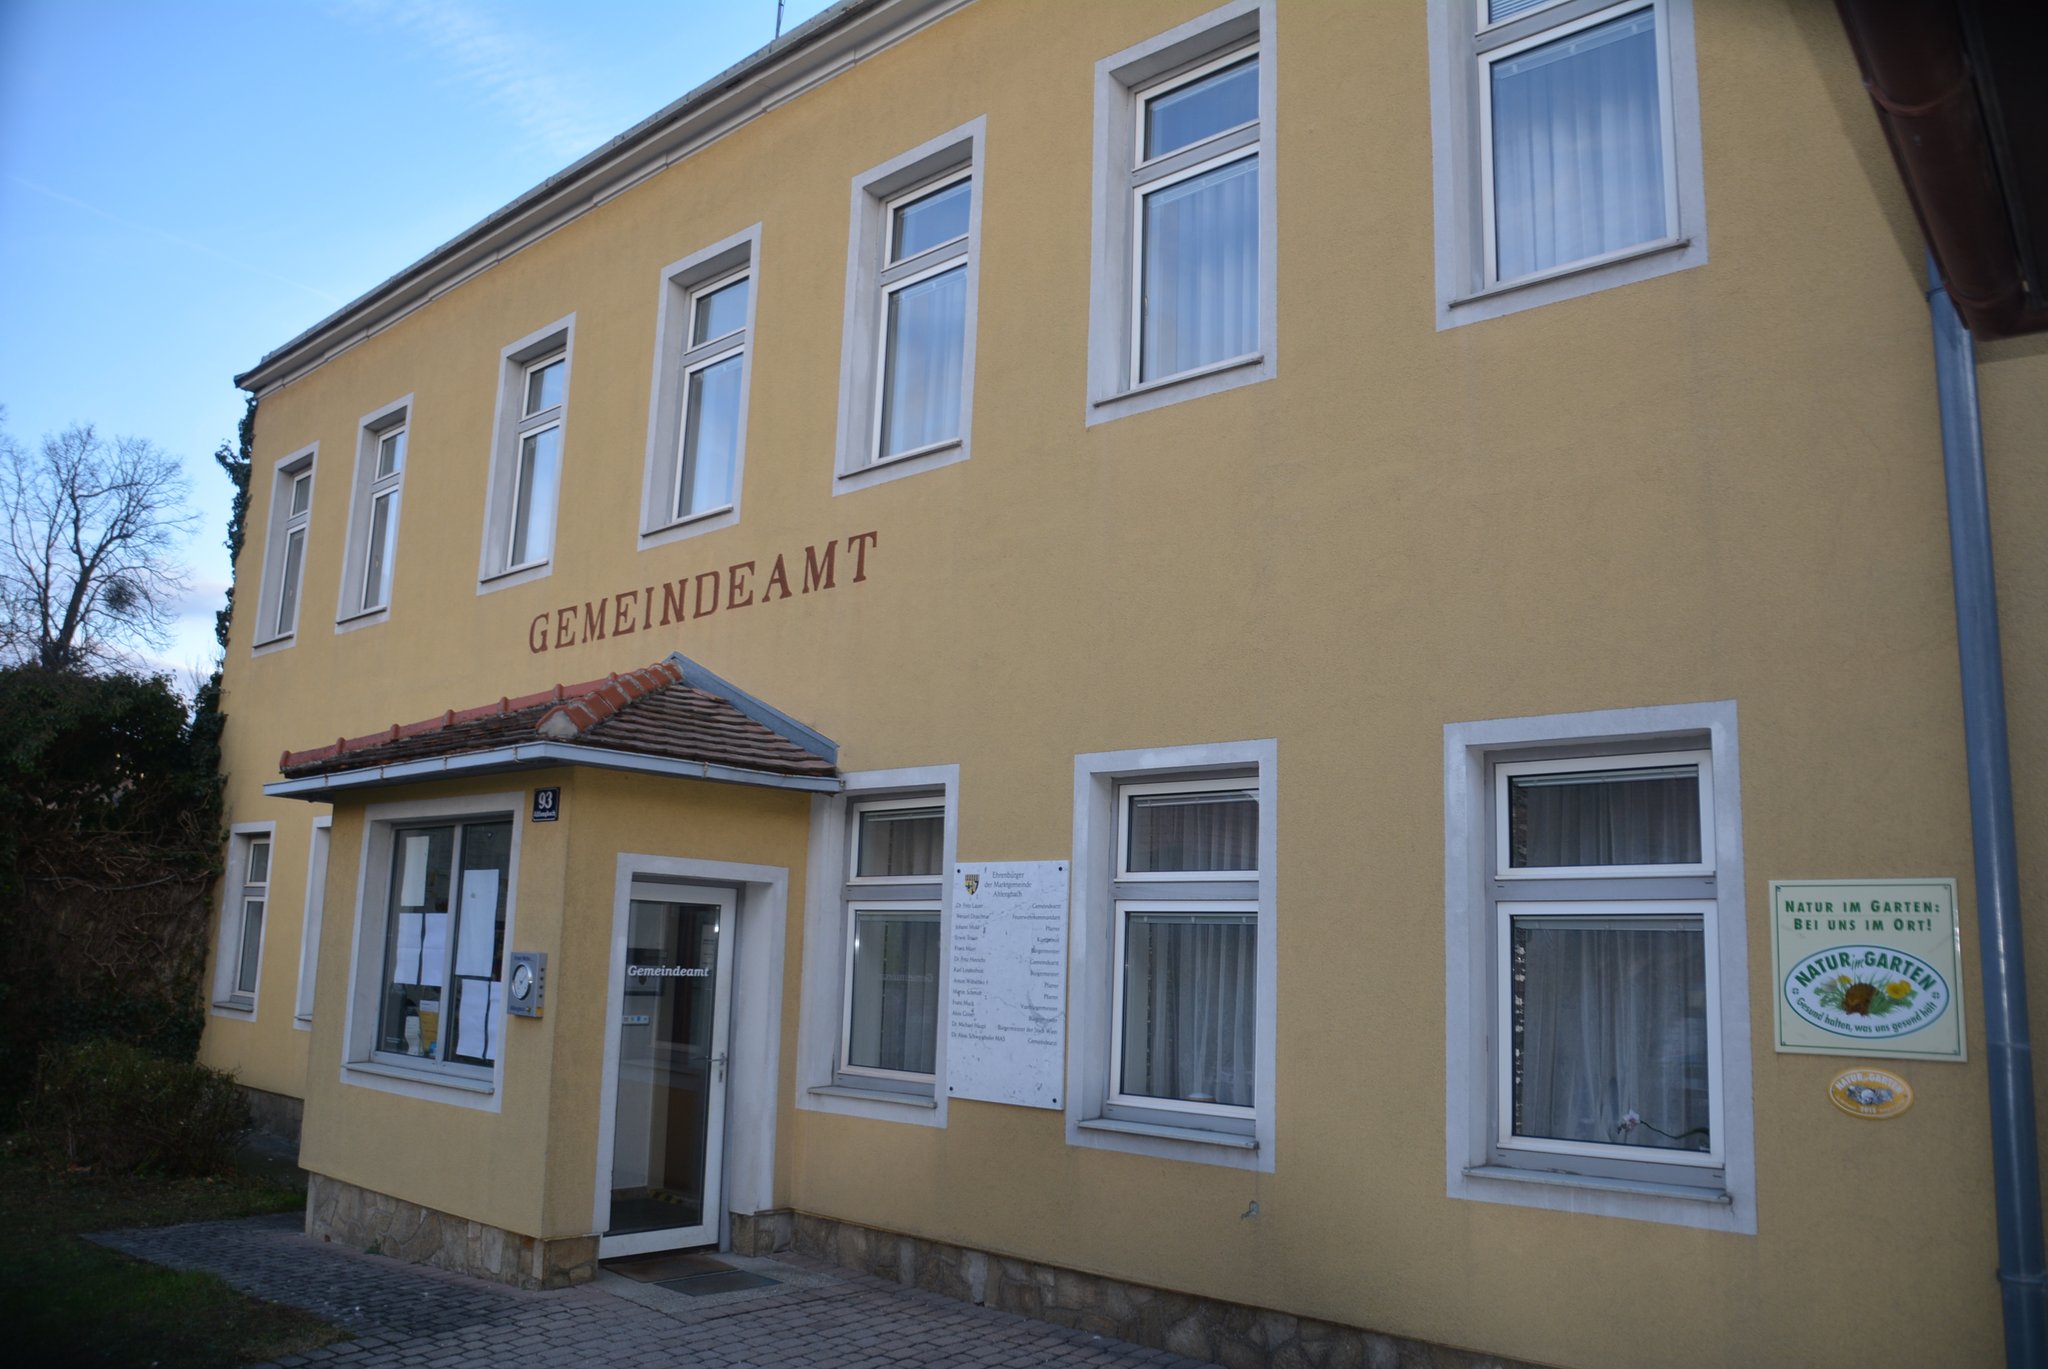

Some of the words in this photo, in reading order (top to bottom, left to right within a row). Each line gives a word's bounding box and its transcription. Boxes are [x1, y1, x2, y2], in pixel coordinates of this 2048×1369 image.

[529, 531, 877, 654] GEMEINDEAMT
[538, 791, 553, 809] 93
[628, 965, 709, 976] Gemeindeamt
[1795, 951, 1850, 987] NATUR
[1864, 951, 1937, 991] GARTEN
[1796, 997, 1824, 1021] Gesund
[1824, 1016, 1853, 1032] halten,
[1855, 1025, 1873, 1033] was
[1892, 1014, 1922, 1033] gesund
[1835, 1072, 1864, 1090] NATUR
